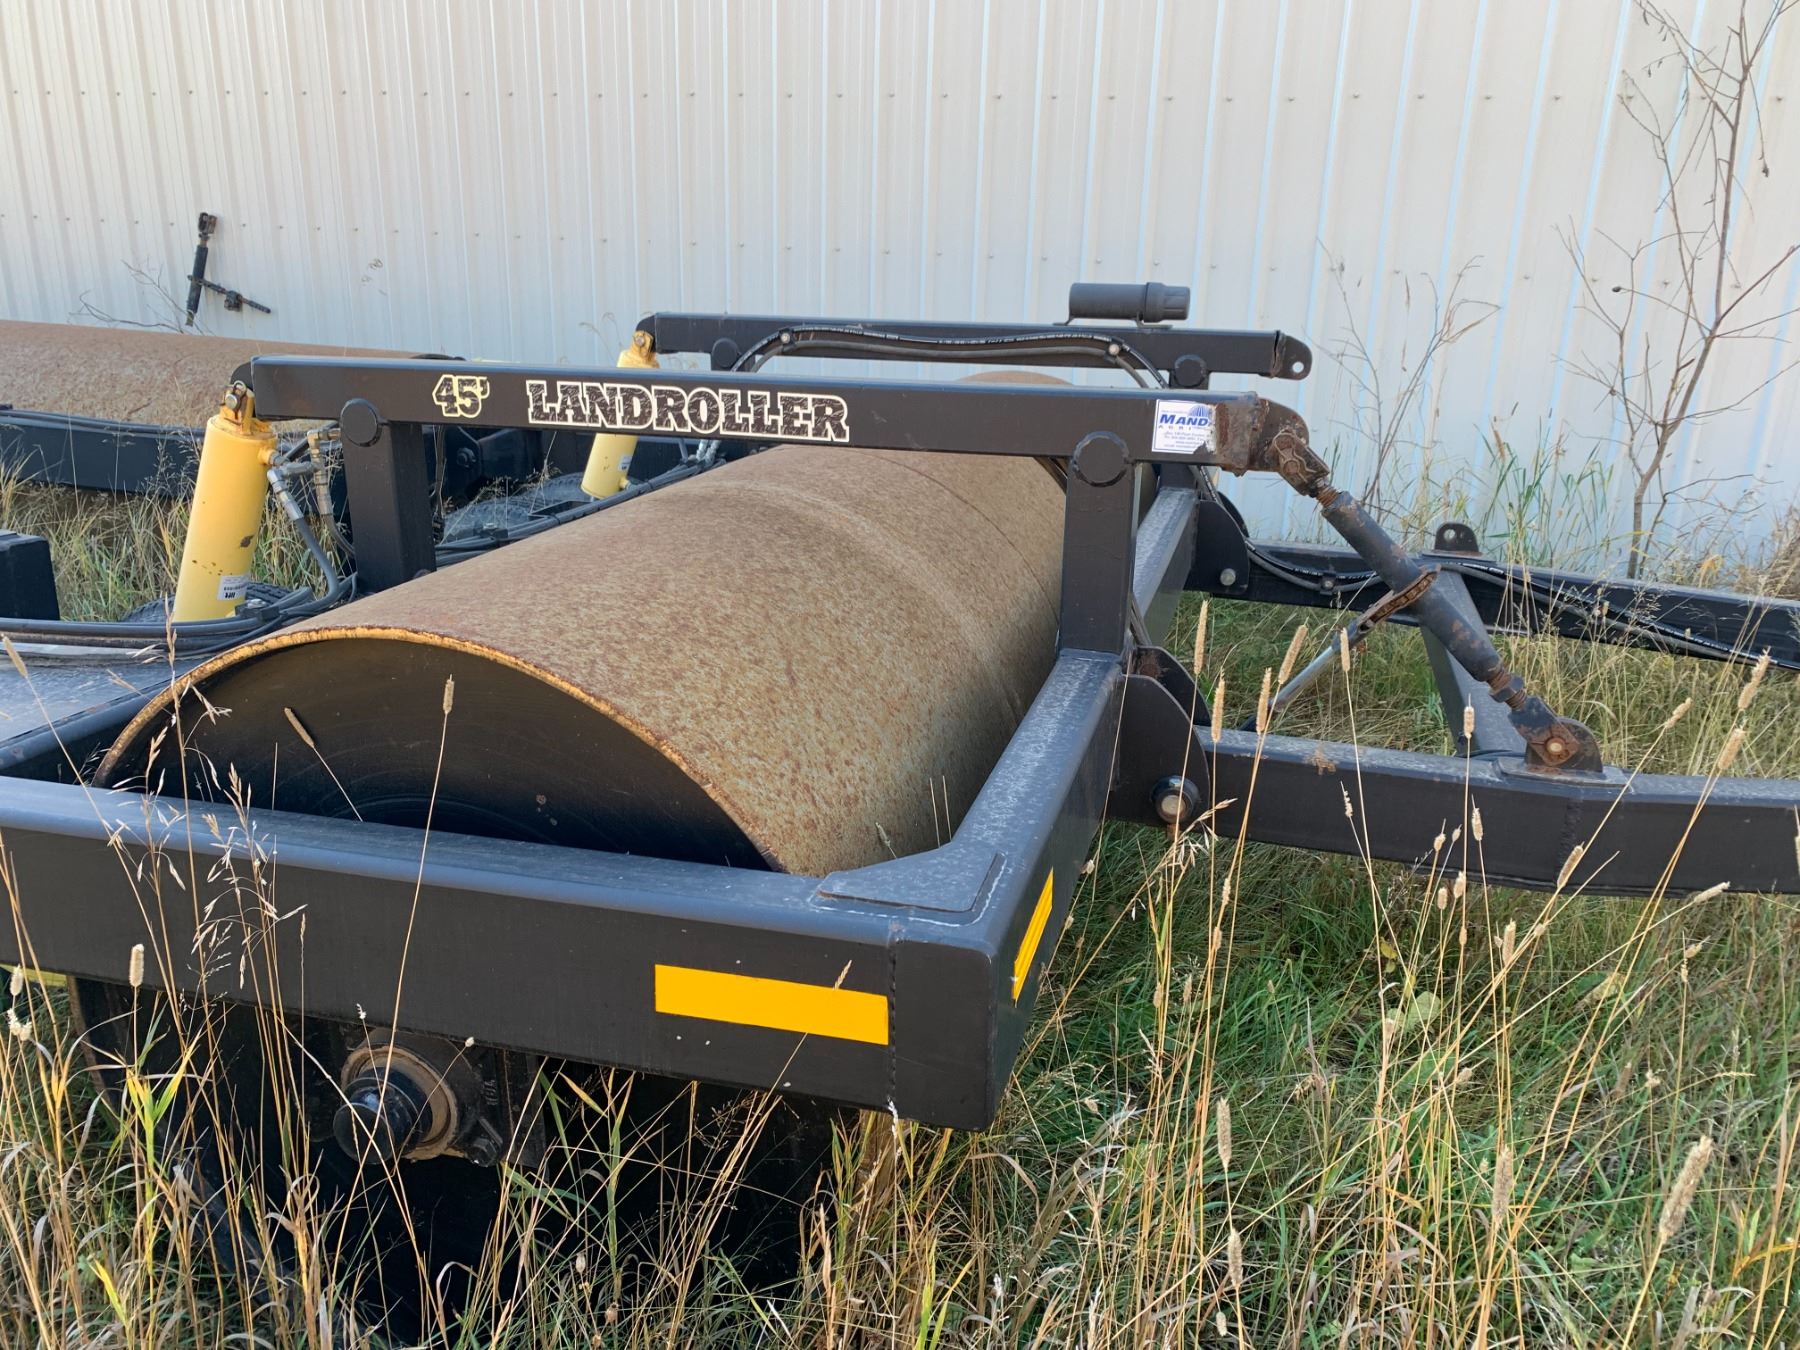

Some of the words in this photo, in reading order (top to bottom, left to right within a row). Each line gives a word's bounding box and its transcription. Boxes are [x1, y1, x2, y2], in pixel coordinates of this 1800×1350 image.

[432, 374, 490, 418] 45'
[526, 379, 850, 442] LANDROLLER
[1159, 413, 1210, 427] MAND
